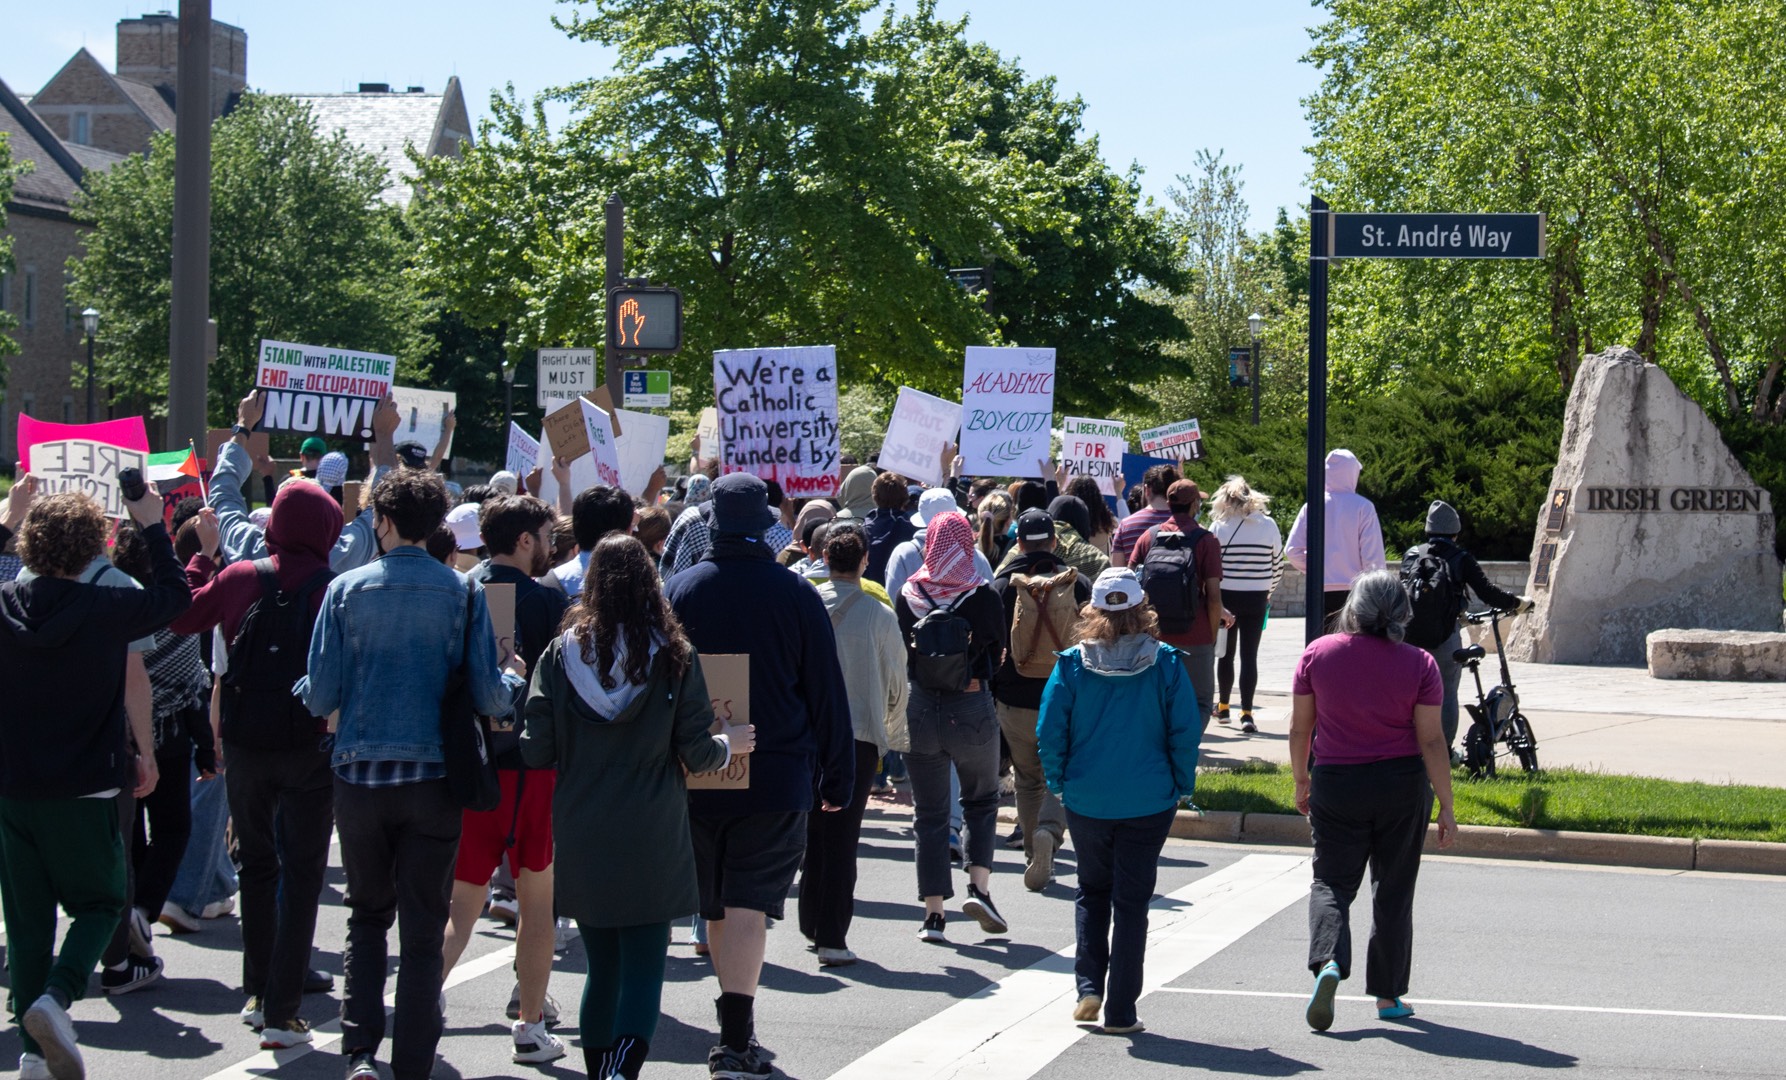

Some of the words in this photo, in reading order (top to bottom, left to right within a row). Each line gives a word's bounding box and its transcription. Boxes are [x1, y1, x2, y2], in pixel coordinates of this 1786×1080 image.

[1361, 224, 1391, 247] St.
[1397, 224, 1462, 247] André
[1468, 224, 1512, 252] Way
[264, 346, 303, 366] STAND
[303, 355, 327, 369] WITH
[327, 354, 391, 376] PALESTINE
[542, 356, 567, 366] RIGHT
[570, 355, 592, 366] LANE
[719, 356, 805, 386] We're
[816, 367, 831, 382] a
[261, 368, 289, 388] END
[289, 378, 305, 390] THE
[305, 373, 388, 398] OCCUPATION
[549, 371, 585, 385] MUST
[965, 372, 1053, 395] ACADEMIC
[542, 390, 565, 400] TURN
[567, 390, 591, 400] RIGH
[718, 385, 816, 414] Catholic
[264, 391, 376, 438] NOW!
[966, 409, 1052, 432] BOYCOTT
[721, 411, 839, 447] University
[1066, 421, 1124, 438] LIBERATION
[1141, 431, 1158, 441] STAND
[1169, 421, 1196, 433] PALESTINE
[1143, 441, 1156, 450] END
[1162, 431, 1199, 447] OCCUPATION
[810, 440, 837, 471] by
[1074, 442, 1106, 459] FOR
[1064, 459, 1120, 478] PALESTINE
[785, 475, 841, 496] Money
[1587, 487, 1661, 511] IRISH
[1670, 487, 1763, 512] GREEN
